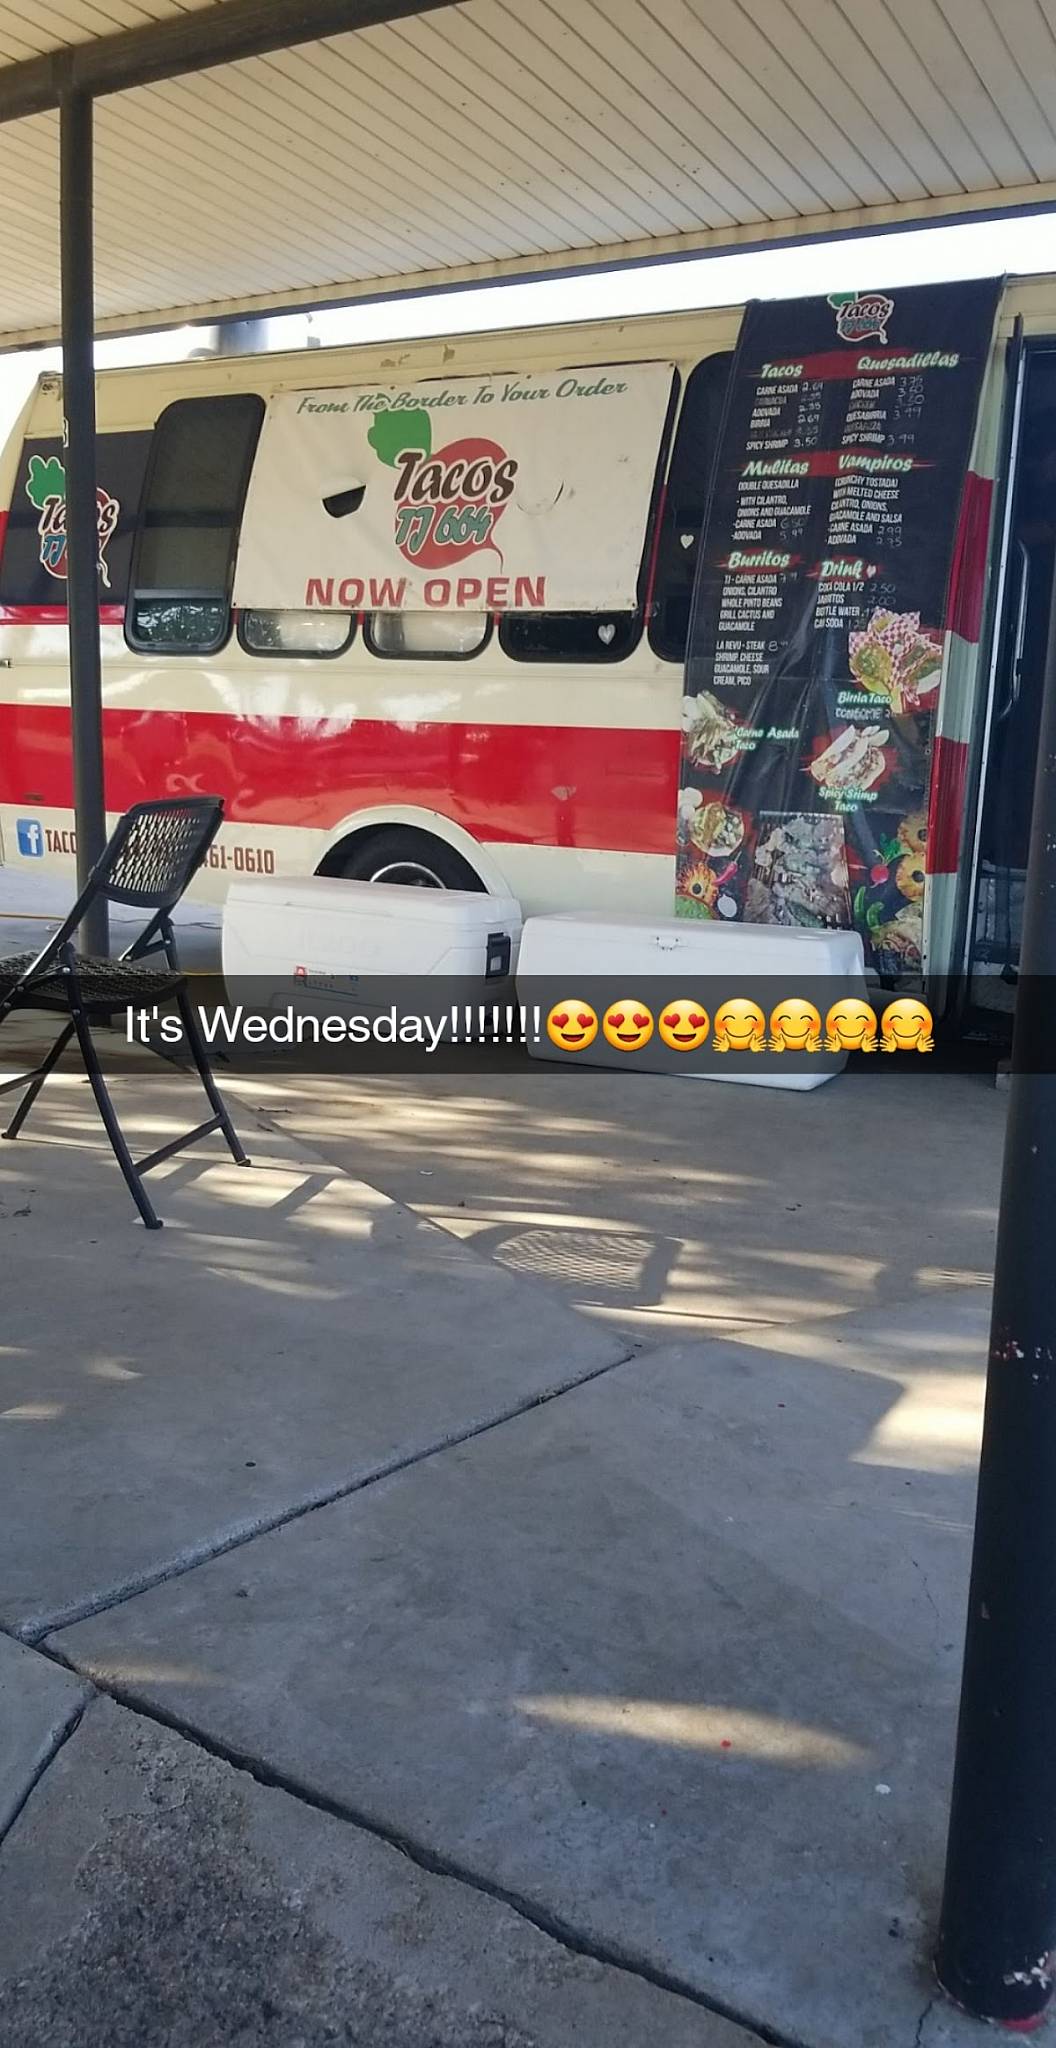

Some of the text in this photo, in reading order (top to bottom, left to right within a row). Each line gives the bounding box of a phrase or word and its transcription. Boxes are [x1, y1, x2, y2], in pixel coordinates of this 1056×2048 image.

[840, 302, 890, 318] Tacos
[857, 351, 960, 370] Quesadillas
[761, 364, 803, 378] Tacos
[853, 379, 874, 388] CARNE
[874, 377, 896, 386] ASADA
[756, 386, 777, 395] CARNE
[777, 384, 798, 394] ASADA
[850, 390, 879, 399] ADOVADA
[297, 378, 628, 414] From The Border To Your Order
[752, 408, 781, 417] ADOVADA
[746, 441, 763, 450] SPICY
[764, 439, 789, 449] SHRIMP
[841, 434, 859, 444] SPICY
[859, 434, 886, 443] SHRIMP
[742, 459, 809, 476] Mulitas
[838, 454, 913, 472] Vampiros
[394, 452, 518, 503] Tacos
[866, 477, 898, 487] TOSTADA)
[739, 479, 799, 490] DOUBLE QUESADILLA
[847, 487, 873, 498] MELTED
[873, 490, 900, 499] CHEESE
[41, 496, 117, 533] Tas
[737, 505, 812, 518] ONIONS AND GUACAMOLE
[756, 518, 777, 528] ASADA
[865, 512, 880, 522] AND
[881, 514, 903, 523] SALSA
[396, 506, 491, 553] TJ 664
[850, 523, 873, 533] ASADA
[728, 551, 790, 569] Burritos
[735, 575, 756, 584] CARNE
[756, 574, 777, 584] ASADA
[306, 576, 545, 606] NOW OPEN
[747, 586, 777, 596] CILANTRO
[834, 581, 850, 592] COLA
[852, 581, 865, 591] 1/2
[721, 598, 783, 608] WHOLE PINTO BEANS
[720, 609, 775, 619] GRILL CACTUS AND
[838, 606, 860, 617] WATER
[719, 621, 755, 632] GUACAMOLE
[825, 617, 844, 628] SODA
[716, 641, 724, 650] LA
[746, 641, 766, 650] STEAK
[740, 652, 764, 662] CHEESE
[753, 664, 770, 674] SOUR
[737, 676, 752, 686] PICO
[837, 690, 892, 704] Birria Taco
[737, 727, 800, 739] Carne Asada
[735, 741, 756, 750] Taco
[819, 787, 844, 800] Spicy
[834, 800, 858, 812] Taco
[204, 845, 275, 875] 61-0610
